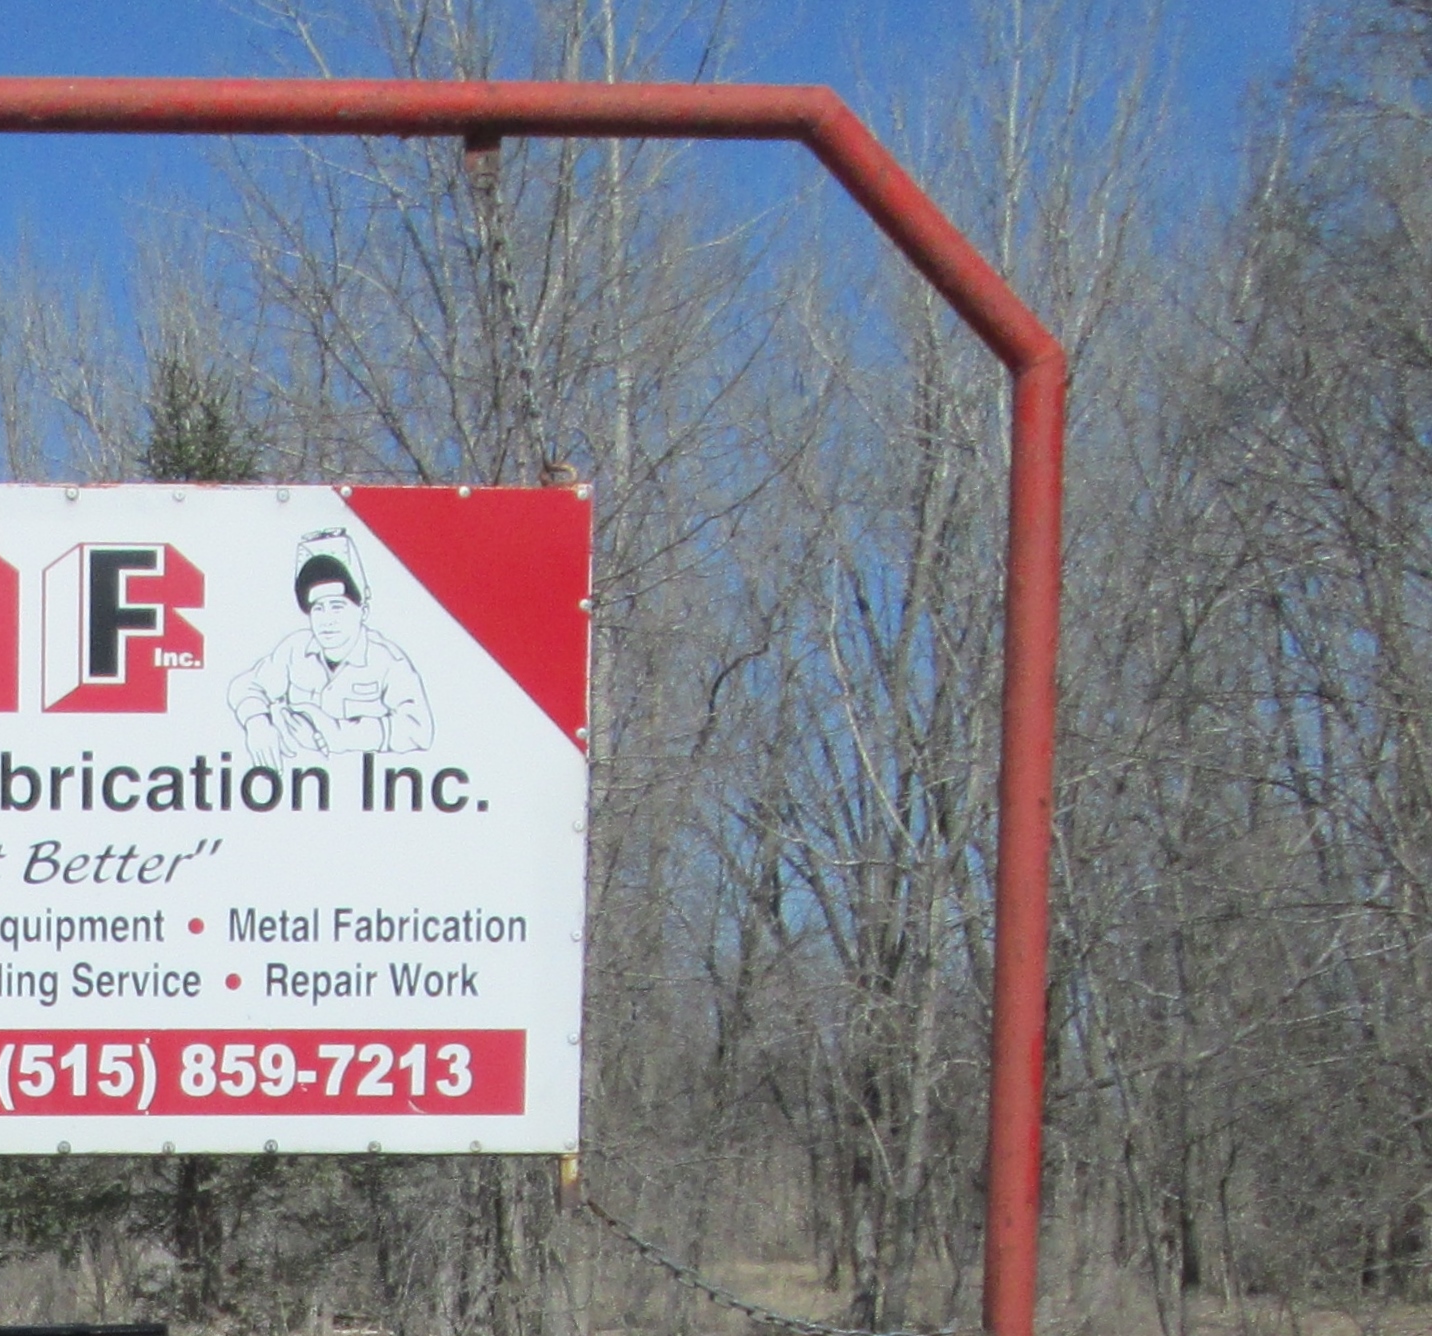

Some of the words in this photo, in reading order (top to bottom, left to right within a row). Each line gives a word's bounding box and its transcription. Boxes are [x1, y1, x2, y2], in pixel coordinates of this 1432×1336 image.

[154, 647, 201, 668] Inc.
[362, 752, 489, 813] Inc.
[229, 908, 319, 943] Metal
[333, 908, 527, 943] Fabrication
[72, 962, 202, 998] Service
[266, 962, 378, 1005] Repair
[389, 963, 479, 998] Work
[179, 1043, 473, 1097] 859-7213
